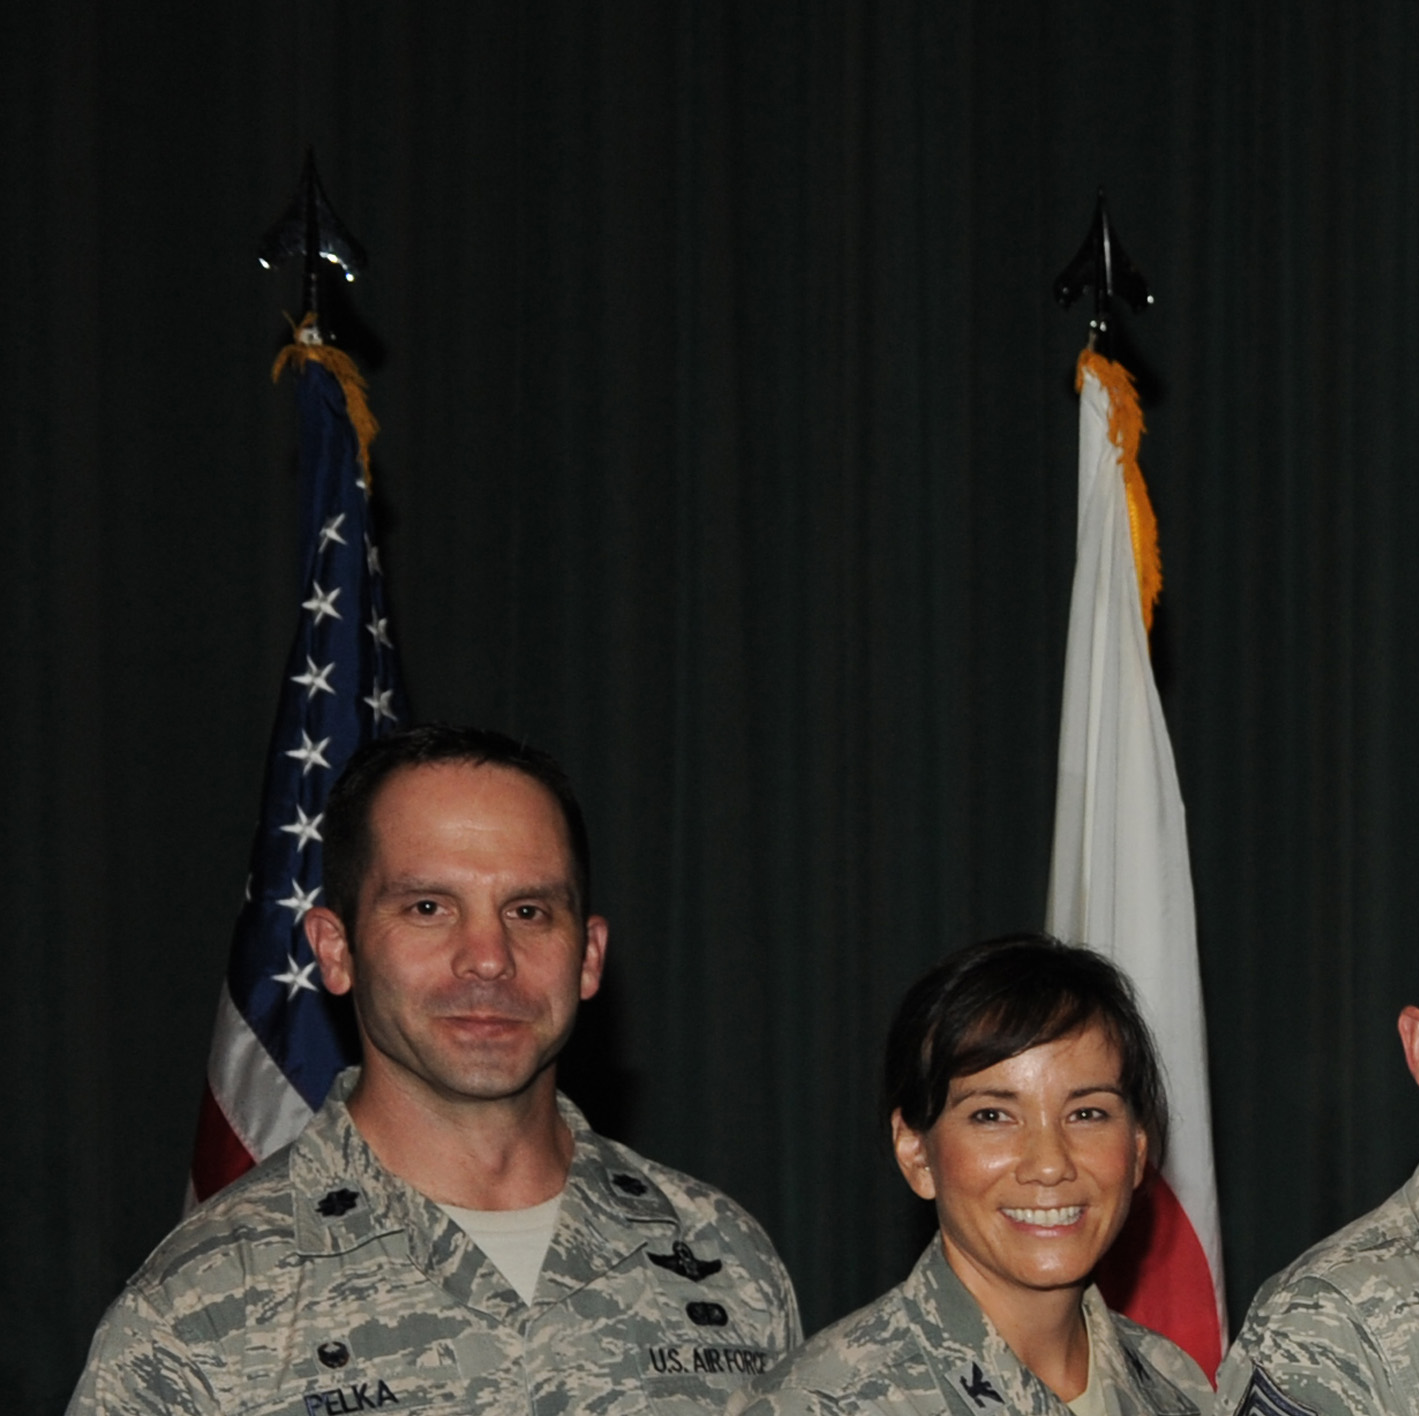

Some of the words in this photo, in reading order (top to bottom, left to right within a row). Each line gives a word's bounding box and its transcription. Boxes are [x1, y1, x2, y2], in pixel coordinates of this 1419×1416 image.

[649, 1348, 689, 1373] U.S.
[693, 1348, 724, 1373] AIR
[723, 1349, 767, 1374] FORCE
